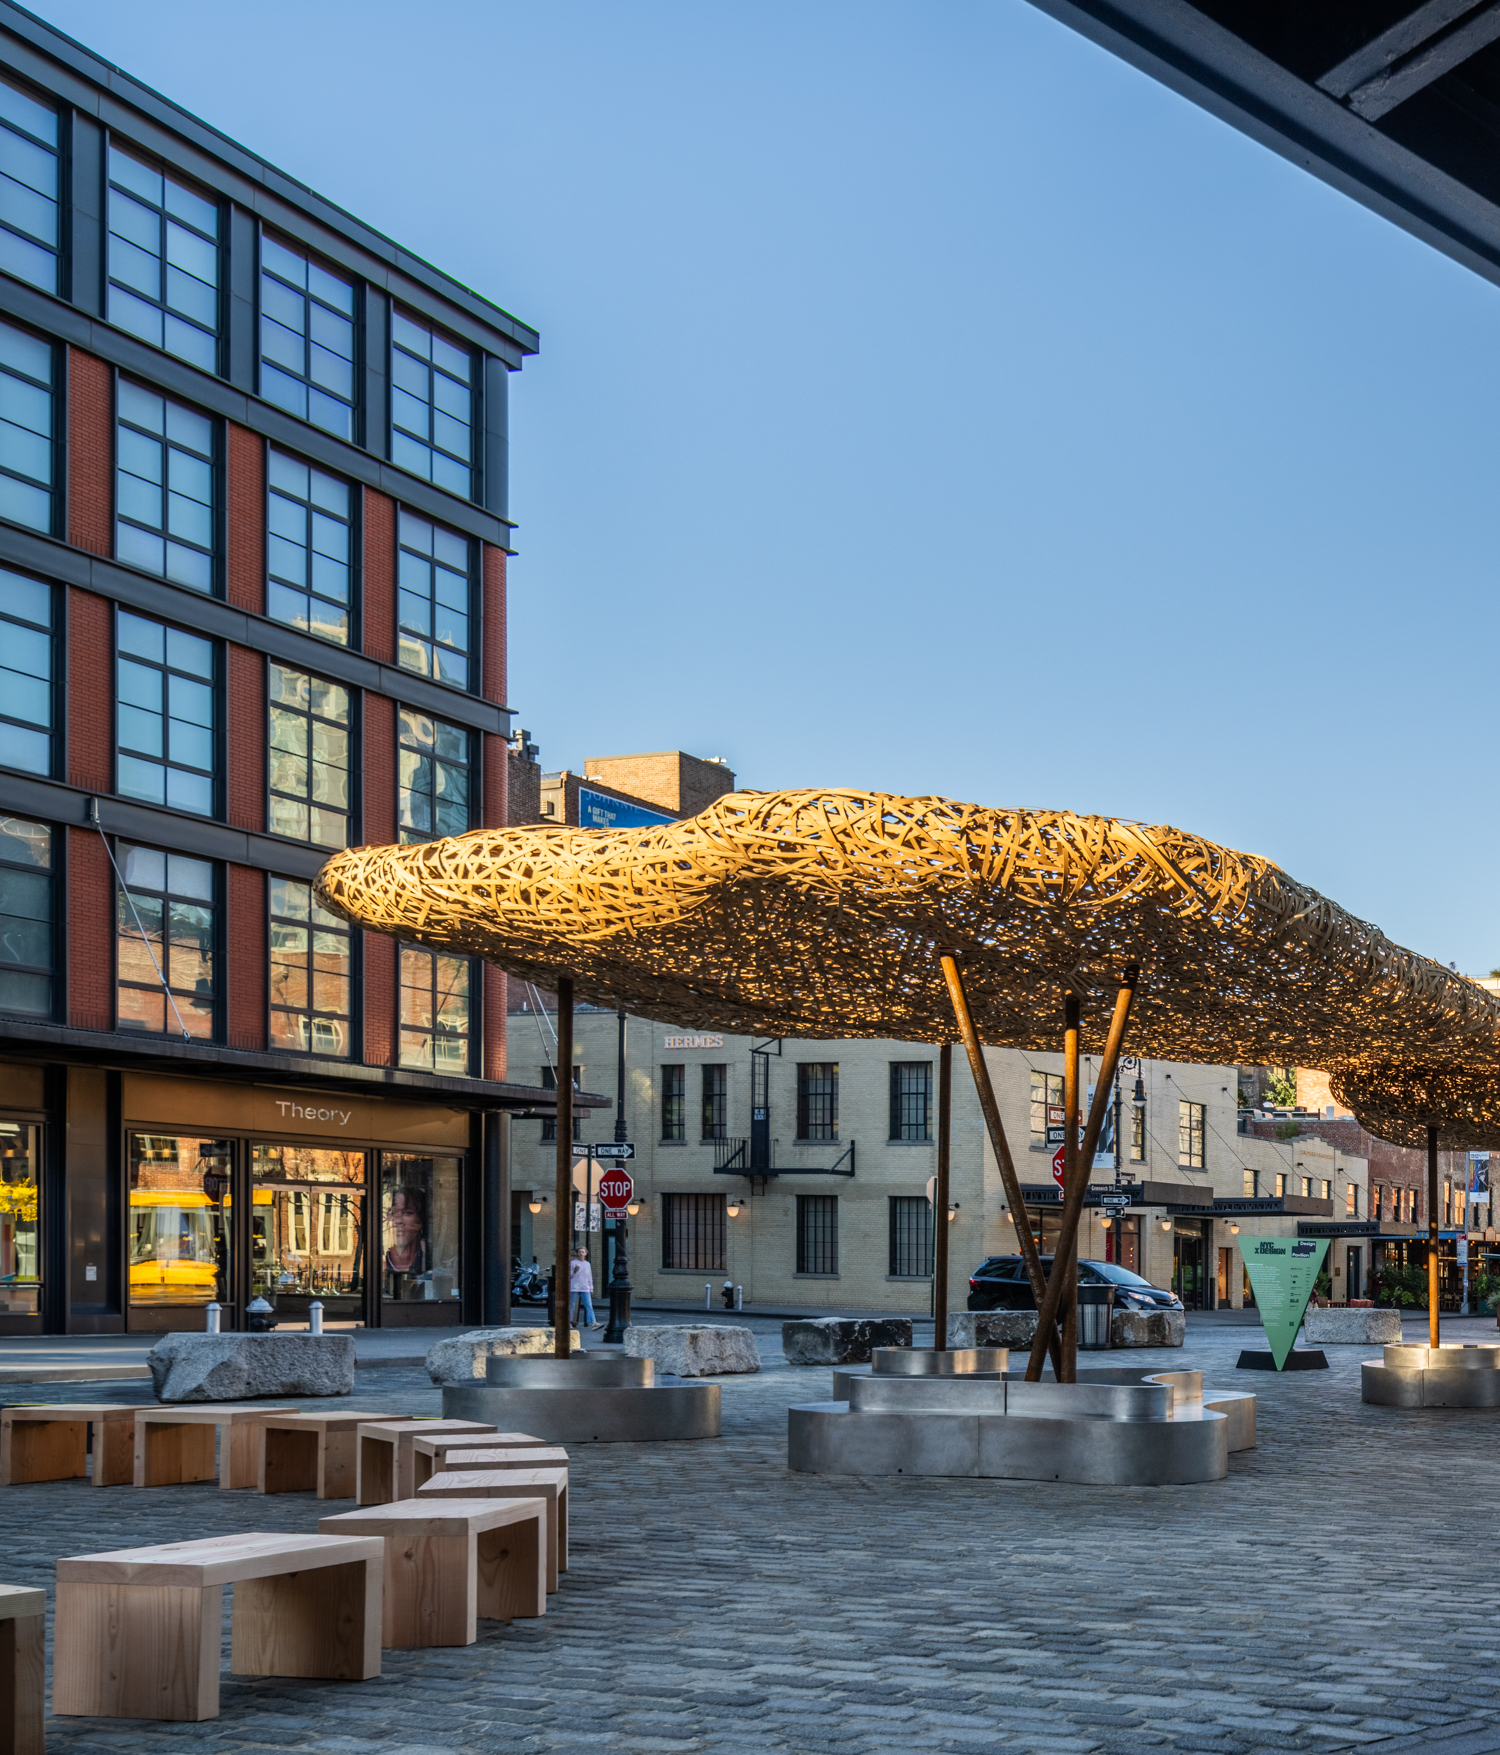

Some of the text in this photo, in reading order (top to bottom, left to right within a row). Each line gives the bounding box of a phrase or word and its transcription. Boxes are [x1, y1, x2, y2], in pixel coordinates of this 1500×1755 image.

[275, 1100, 352, 1126] Theory
[1053, 1111, 1064, 1120] ONE
[600, 1147, 629, 1155] ONE WAY
[600, 1181, 631, 1197] STOP
[1260, 1241, 1275, 1249] NYC
